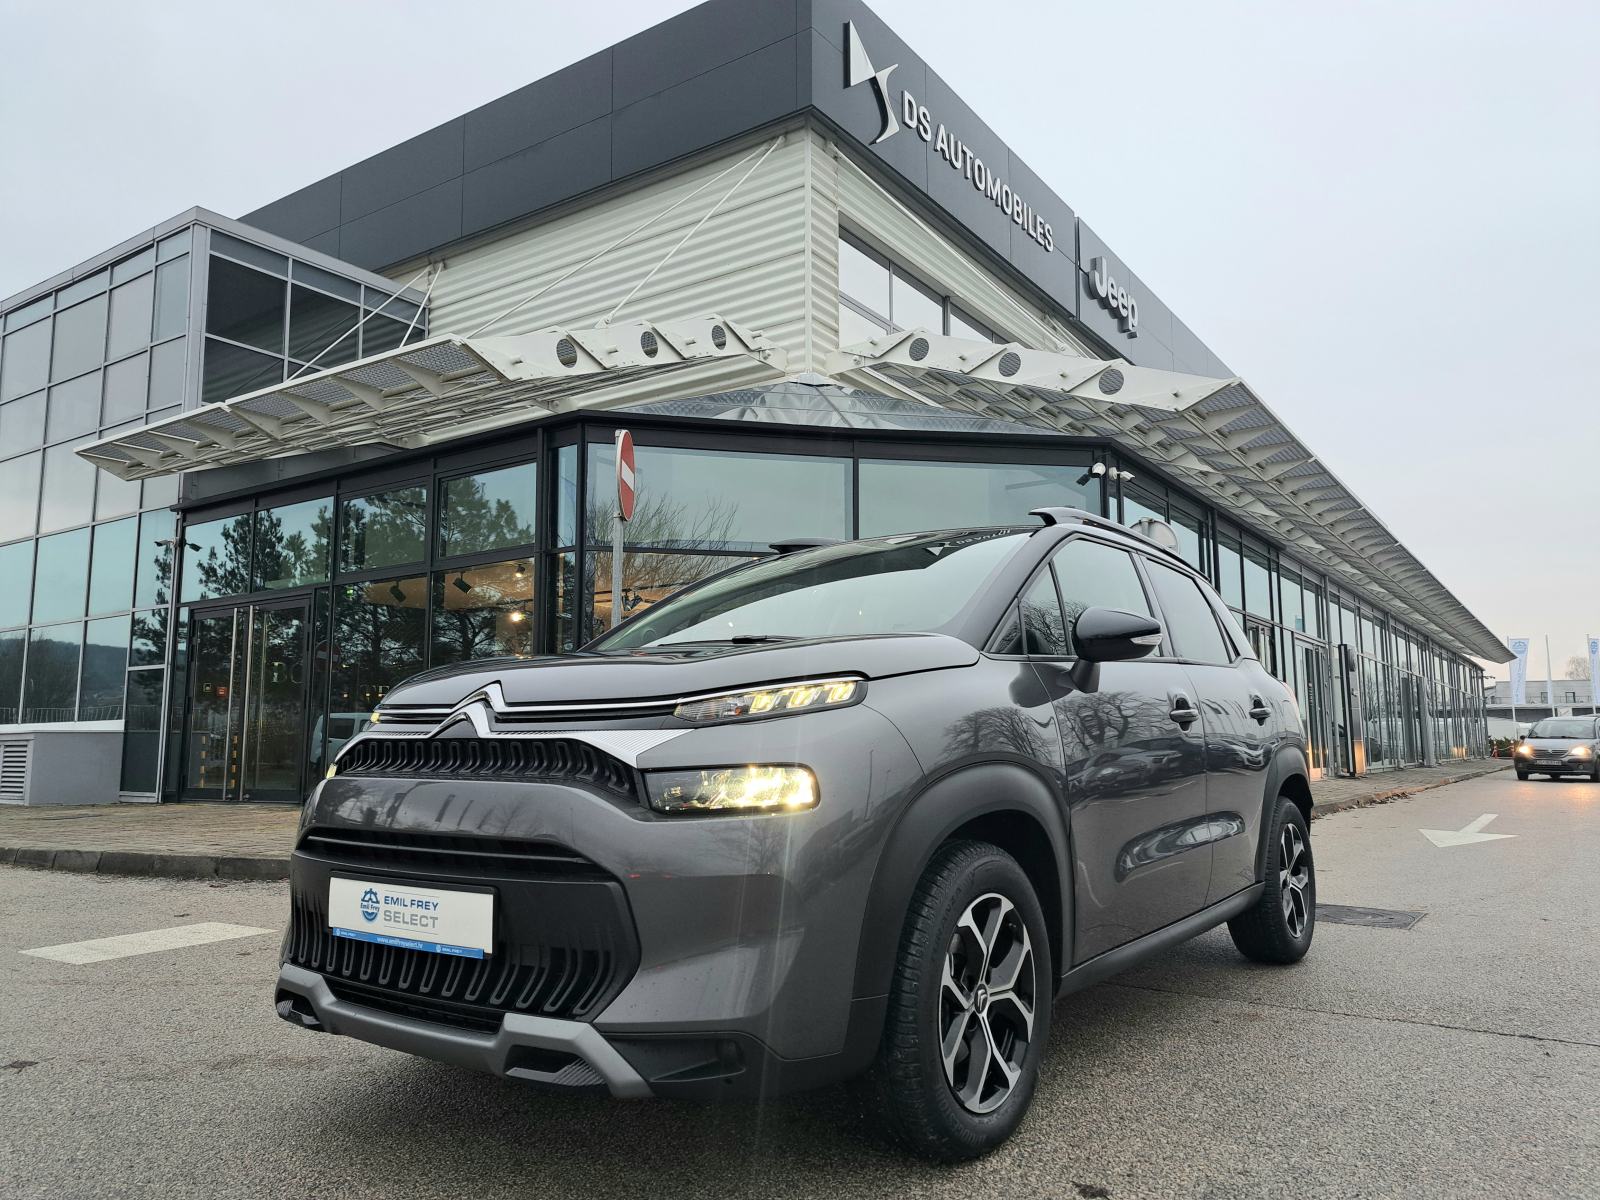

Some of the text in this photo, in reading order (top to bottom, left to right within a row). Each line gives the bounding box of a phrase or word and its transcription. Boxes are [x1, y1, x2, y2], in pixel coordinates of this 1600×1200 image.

[903, 90, 1053, 252] DS AUTOMOBILES
[1090, 256, 1138, 334] Jeep
[383, 909, 439, 928] SELECT
[384, 895, 439, 911] EMIL FREY
